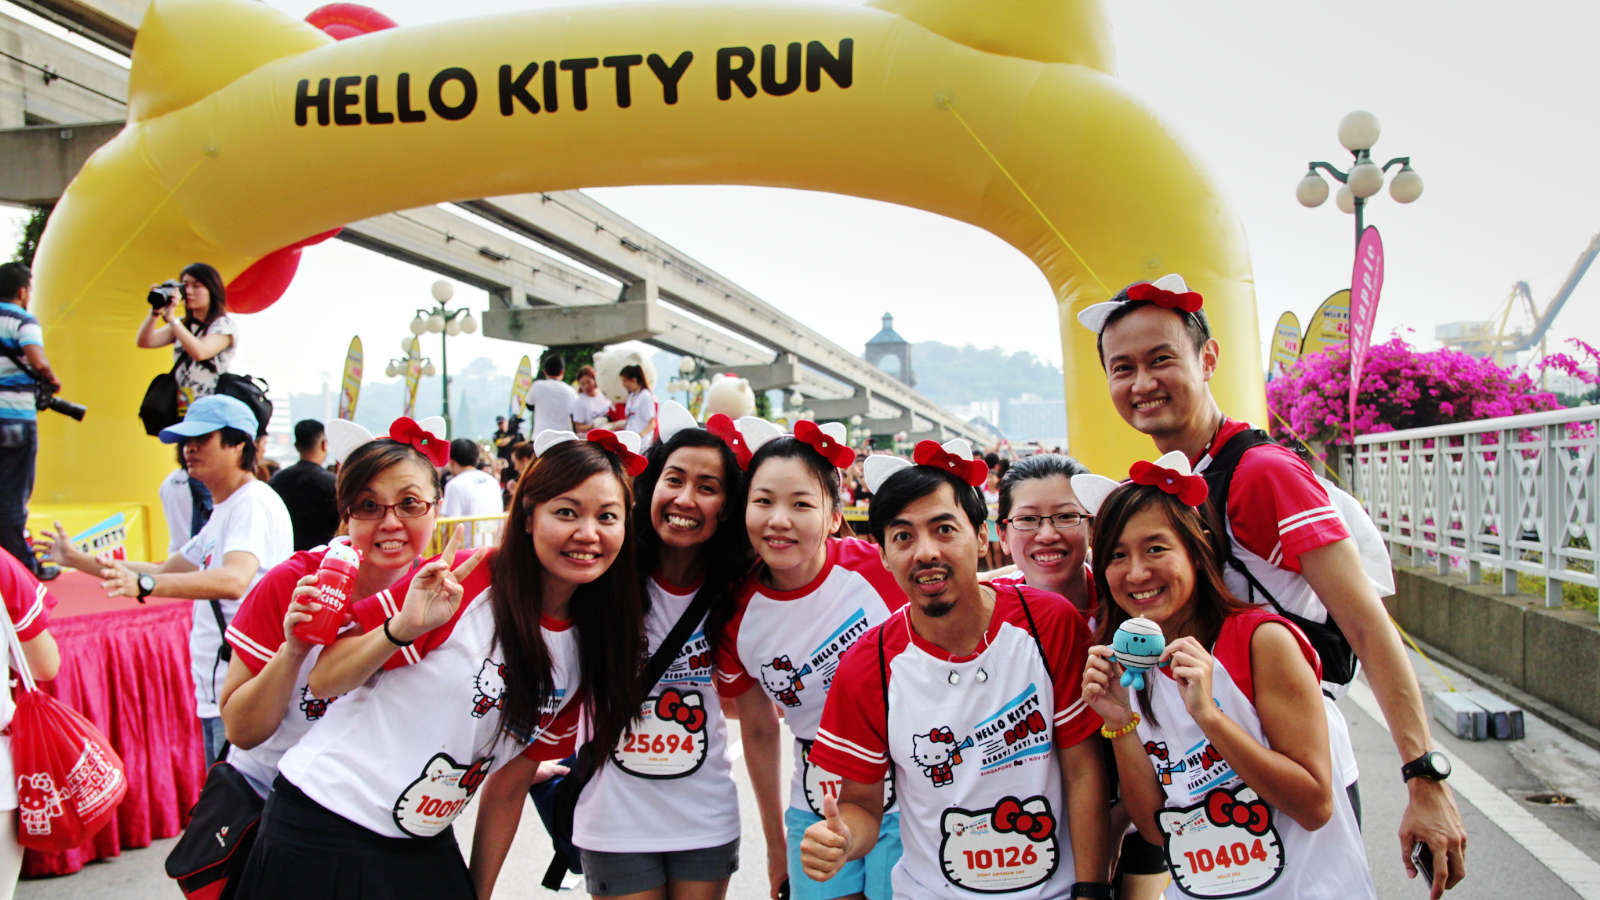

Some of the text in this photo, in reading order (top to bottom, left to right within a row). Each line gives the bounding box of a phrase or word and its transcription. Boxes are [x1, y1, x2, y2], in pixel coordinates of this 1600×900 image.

[294, 38, 854, 126] HELLO KITTY RUN
[321, 584, 346, 601] Hello
[811, 617, 869, 668] HELLO KITTY
[688, 650, 711, 671] RU
[975, 694, 1040, 742] HELLO KITTY
[1003, 709, 1047, 746] RUN
[623, 733, 695, 754] 25694
[981, 733, 1049, 766] READY! SET! GO!
[962, 843, 1038, 870] 10126
[1183, 838, 1268, 874] 10404
